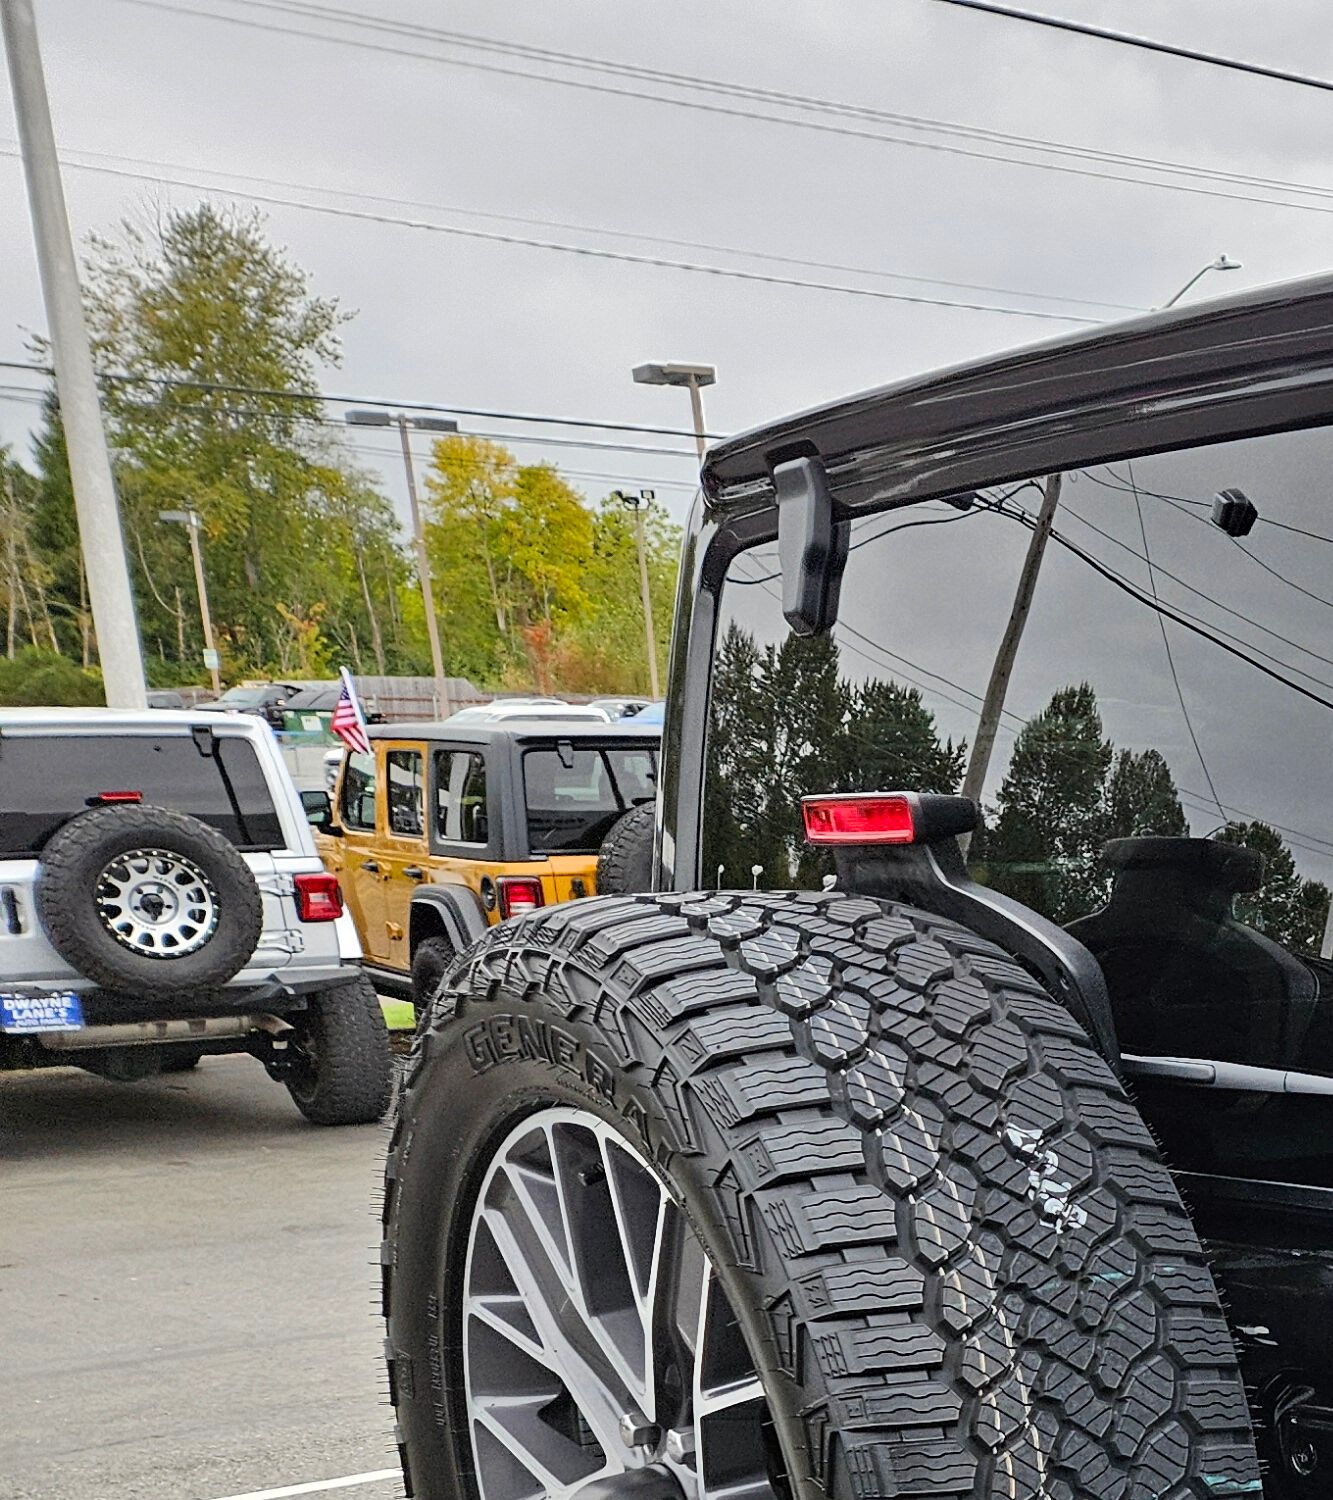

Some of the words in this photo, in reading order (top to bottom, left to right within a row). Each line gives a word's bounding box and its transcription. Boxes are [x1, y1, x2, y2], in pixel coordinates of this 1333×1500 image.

[3, 997, 72, 1010] DWAYNE
[12, 1007, 69, 1019] LANE'S
[461, 1013, 686, 1200] GENERAL
